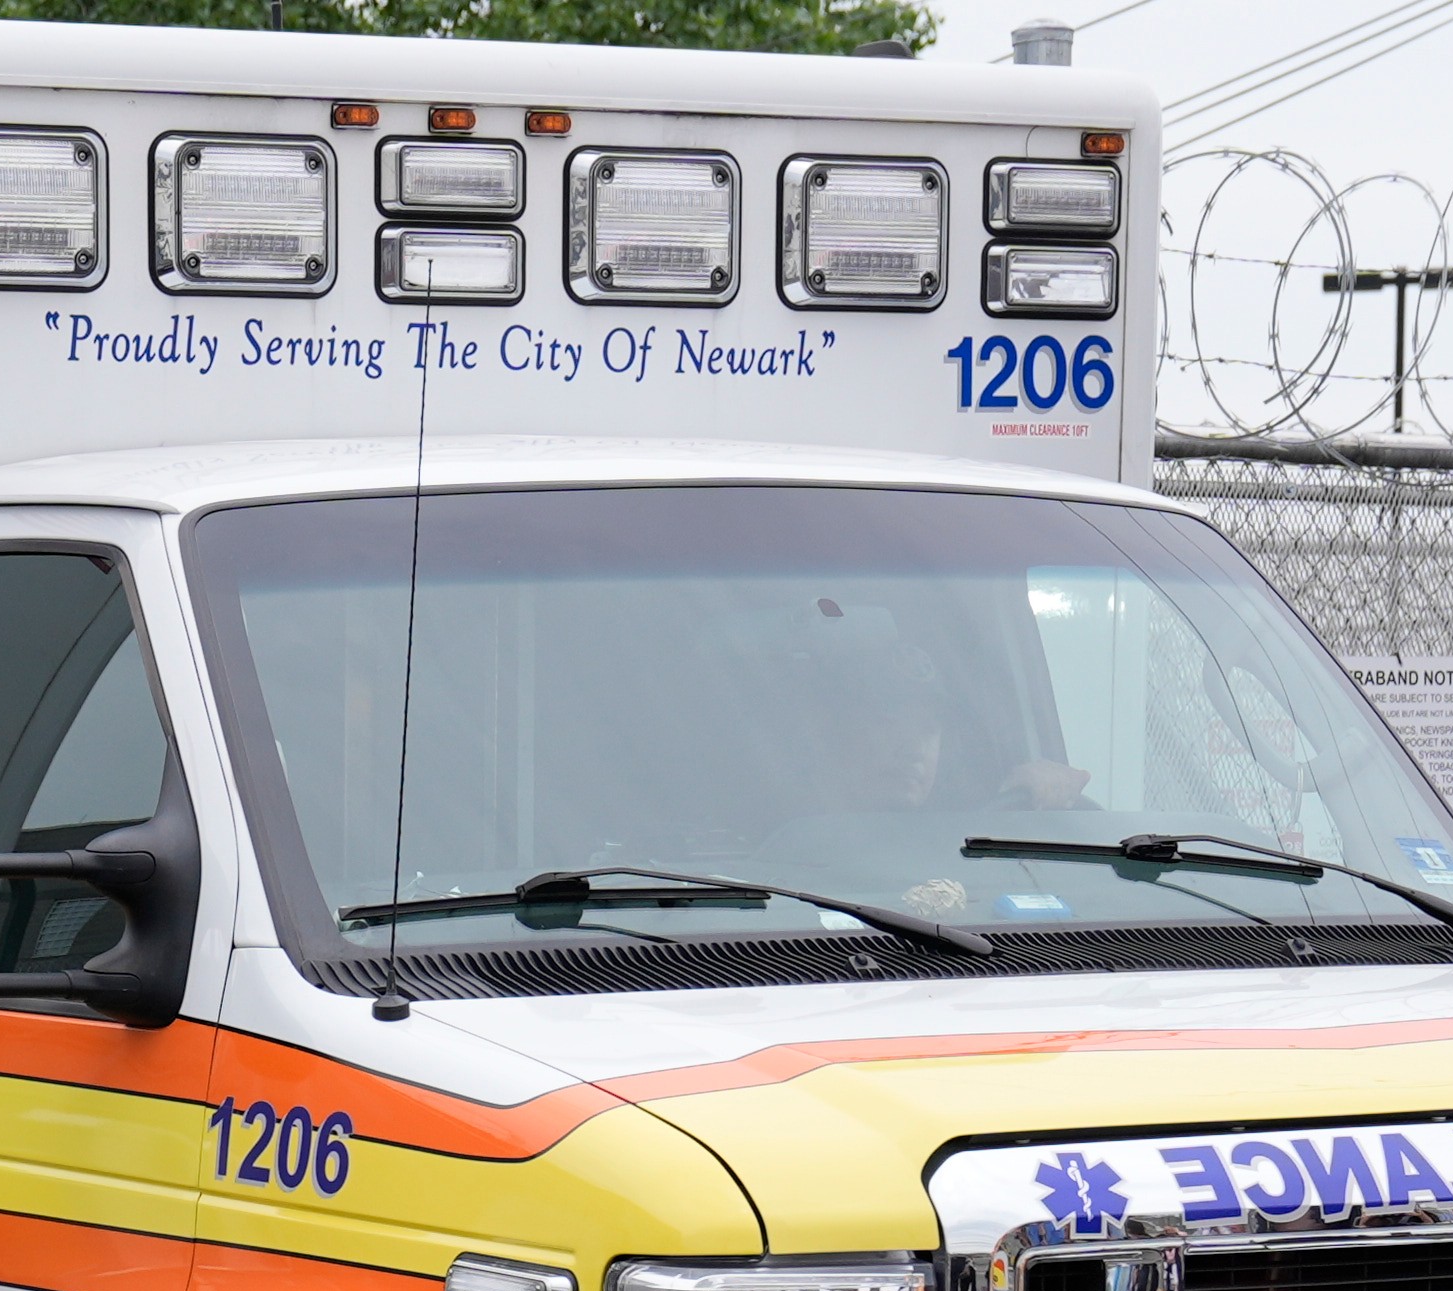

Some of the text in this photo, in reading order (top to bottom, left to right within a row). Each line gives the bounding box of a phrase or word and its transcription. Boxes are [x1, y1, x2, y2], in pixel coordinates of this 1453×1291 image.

[240, 320, 385, 377] Serving
[406, 322, 478, 370] The
[499, 326, 583, 380] City
[603, 327, 656, 382] Of
[946, 334, 1115, 412] 1206
[992, 424, 1028, 436] MAXIMUM
[1029, 424, 1070, 436] CLEARANCE
[1389, 694, 1427, 703] SUBJECT
[1431, 694, 1442, 703] TO
[209, 1095, 354, 1199] 1206
